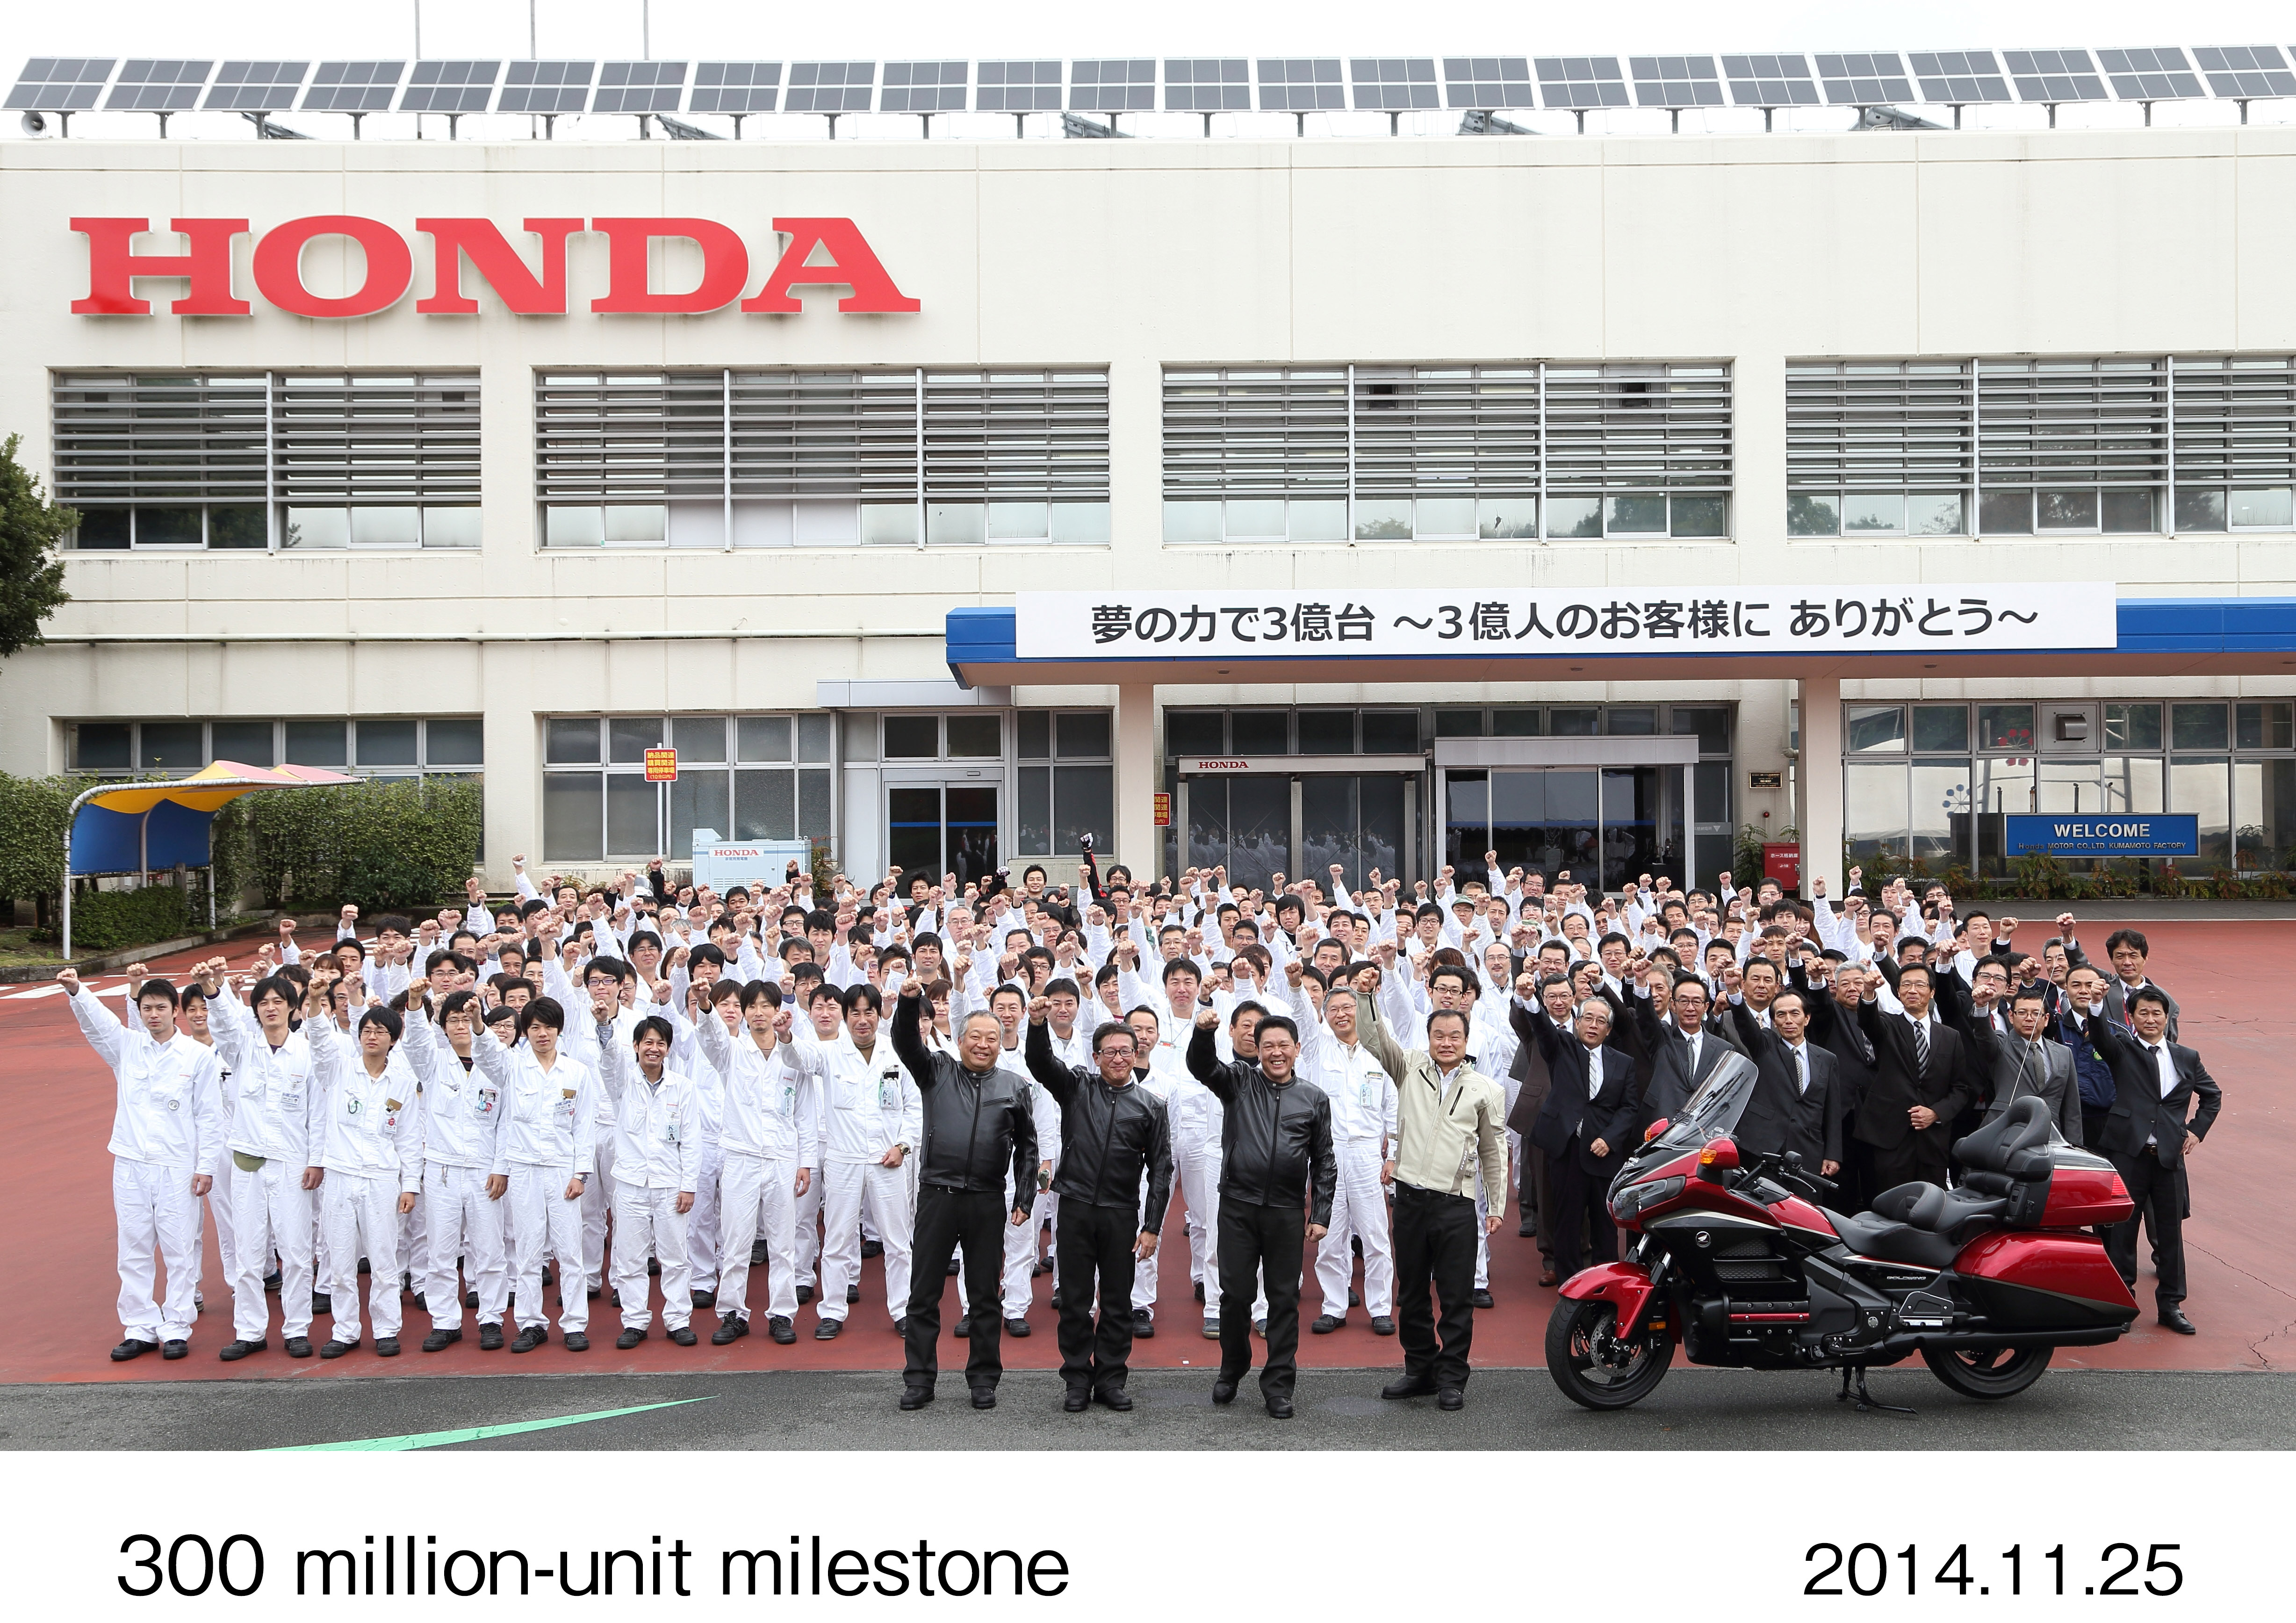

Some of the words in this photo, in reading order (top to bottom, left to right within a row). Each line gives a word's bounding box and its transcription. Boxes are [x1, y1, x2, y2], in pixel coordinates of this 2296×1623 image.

[70, 215, 921, 317] HONDA
[1092, 603, 1375, 644] 夢の力で3億台
[2054, 823, 2151, 838] WELCOME
